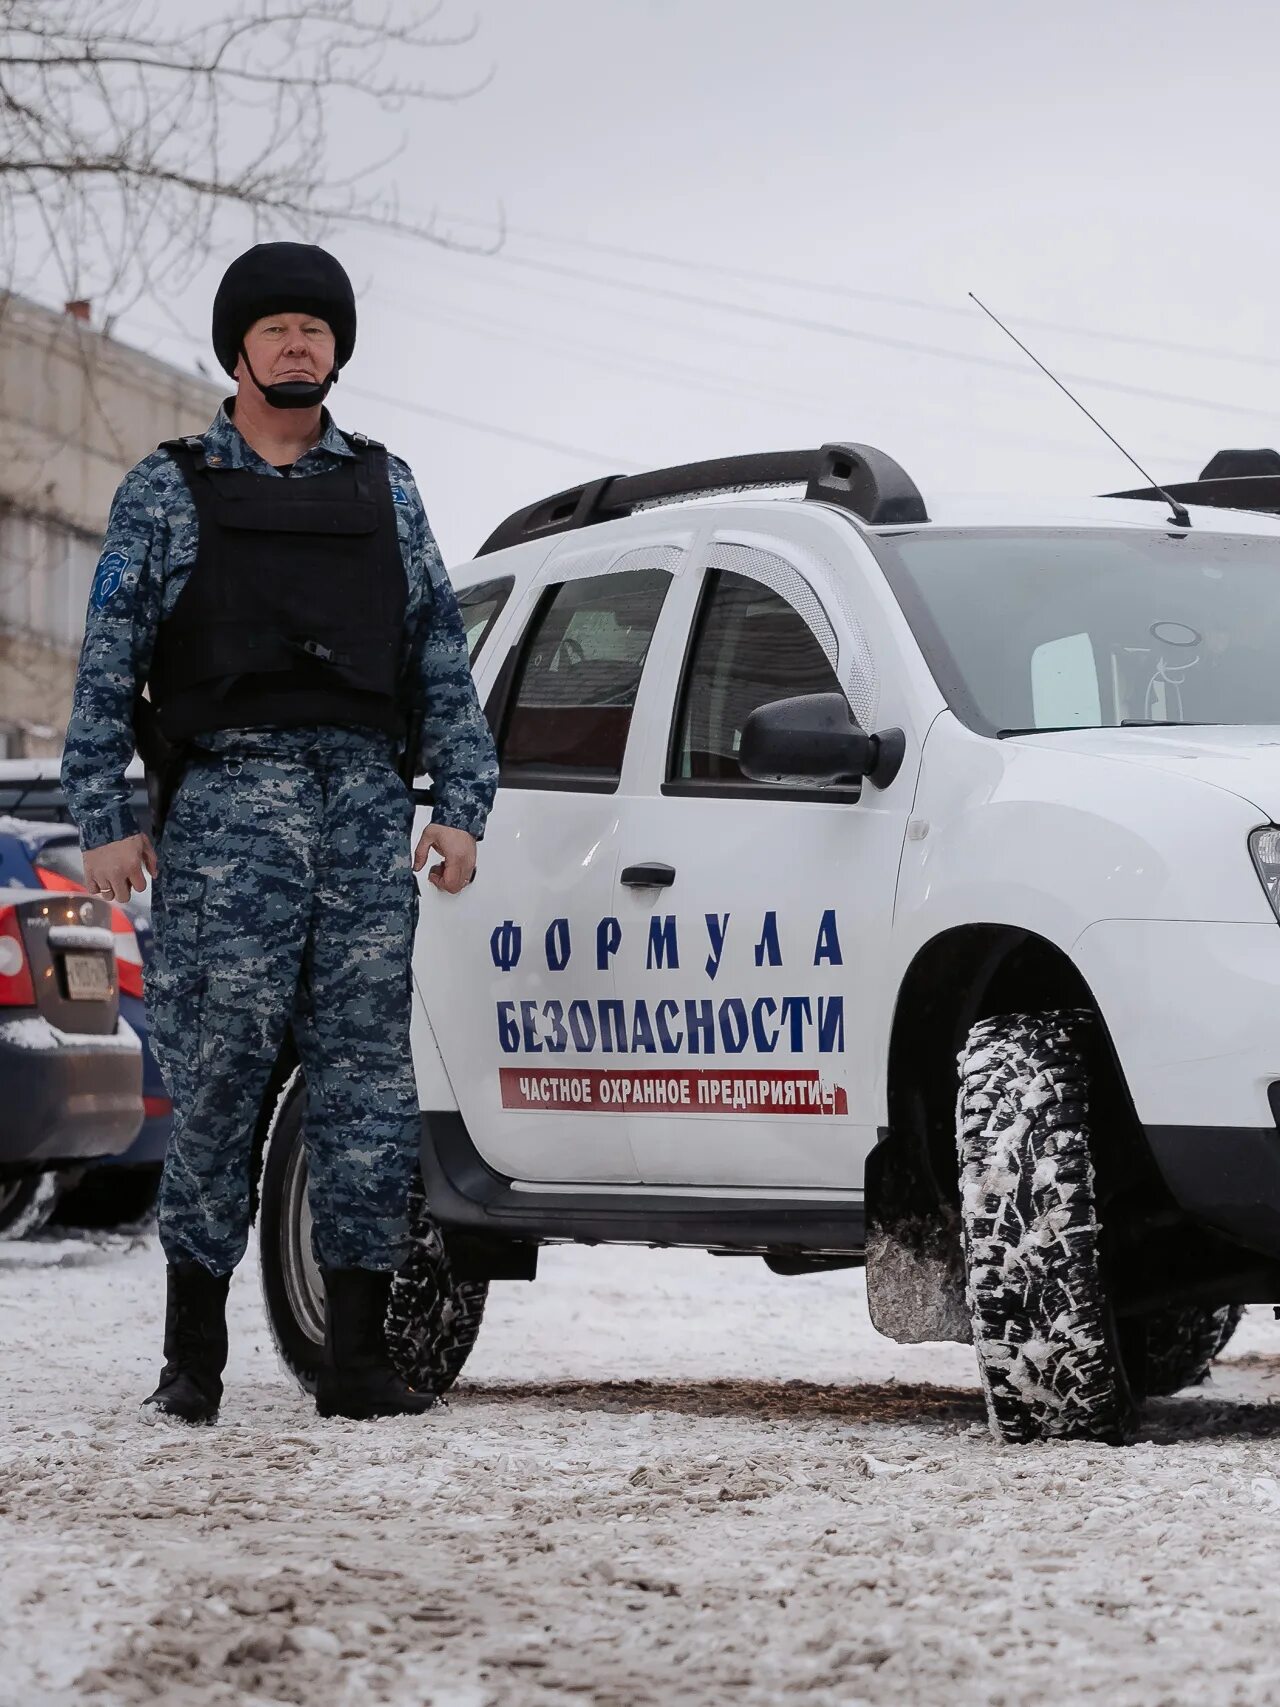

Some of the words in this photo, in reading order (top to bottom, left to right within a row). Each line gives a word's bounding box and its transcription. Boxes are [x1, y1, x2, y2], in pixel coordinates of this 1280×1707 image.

[490, 909, 844, 981] ФОРМУЛА
[496, 996, 845, 1054] БЕЗОПАСНОСТИ
[519, 1077, 592, 1103] ЧАСТНОЕ
[600, 1079, 691, 1104] ОХРАННОЕ
